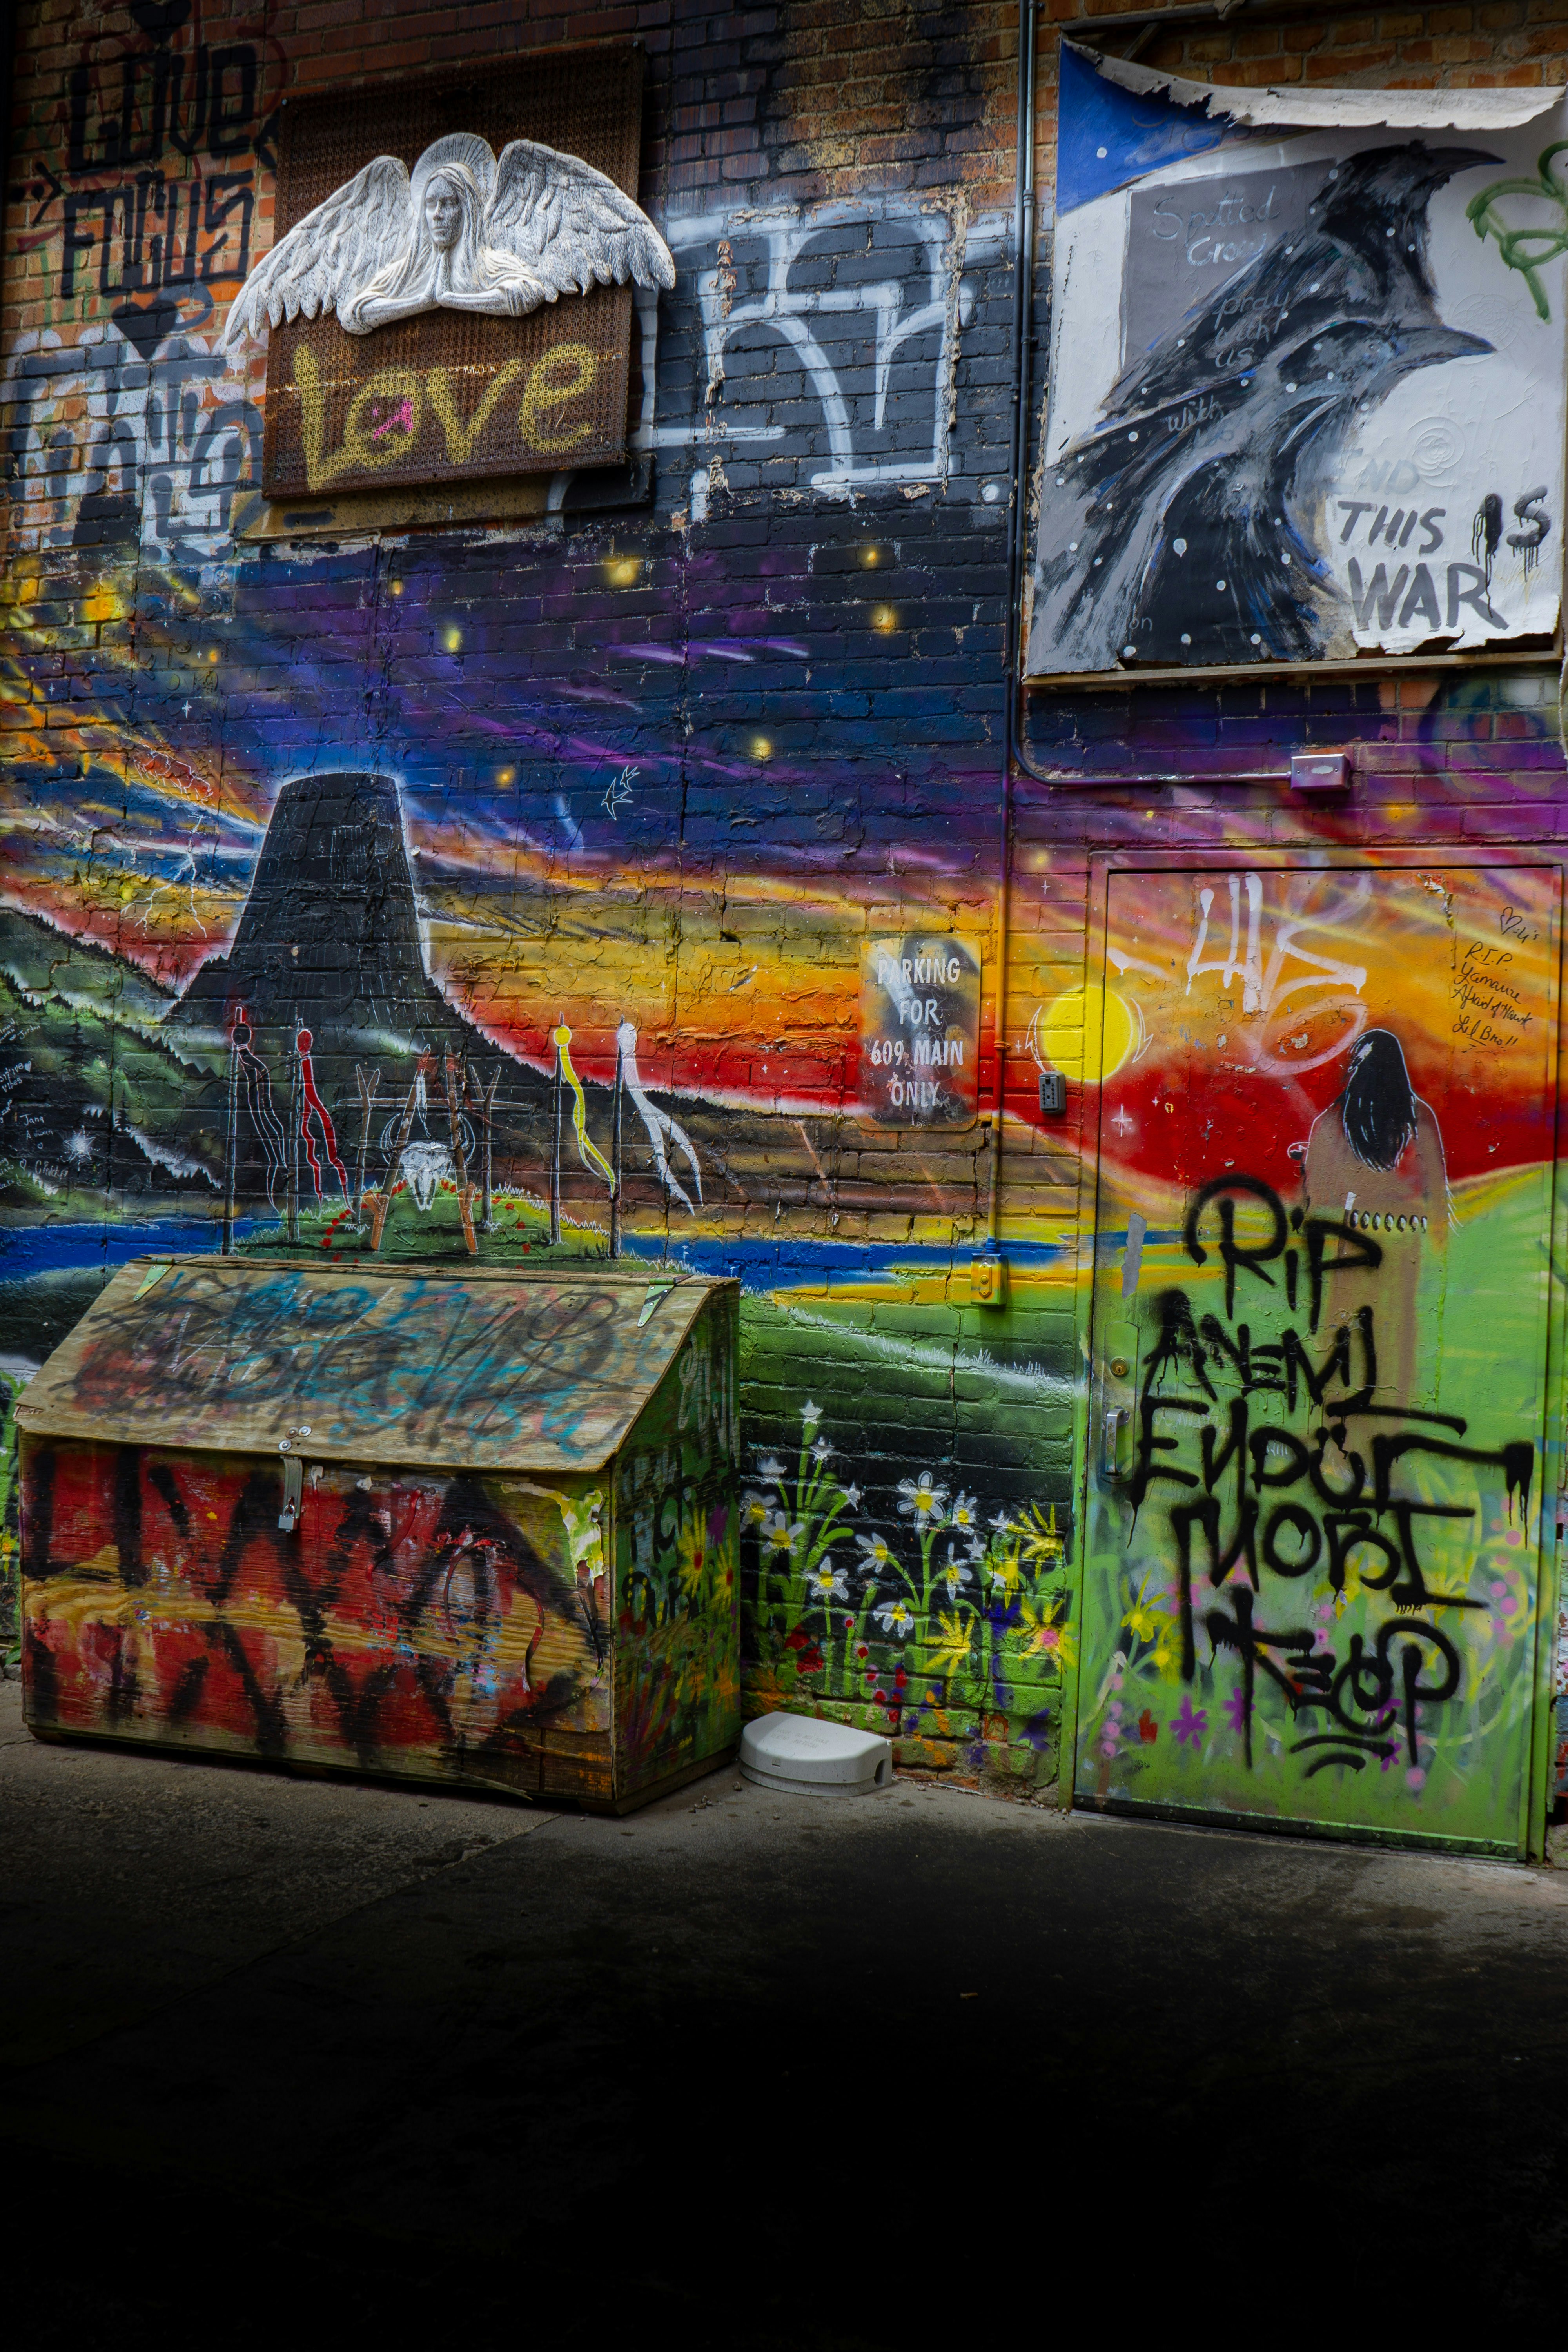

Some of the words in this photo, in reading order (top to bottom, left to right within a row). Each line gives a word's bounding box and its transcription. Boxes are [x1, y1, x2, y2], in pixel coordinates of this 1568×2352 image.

[1153, 186, 1280, 247] Spotted
[1212, 291, 1290, 334] pray
[1215, 348, 1255, 368] us
[1337, 500, 1446, 554] THIS
[1348, 557, 1510, 632] WAR
[878, 957, 960, 984] PARKING
[899, 999, 941, 1025] FOR
[871, 1040, 904, 1065] 609
[914, 1040, 964, 1066] MAIN
[891, 1081, 941, 1107] ONLY
